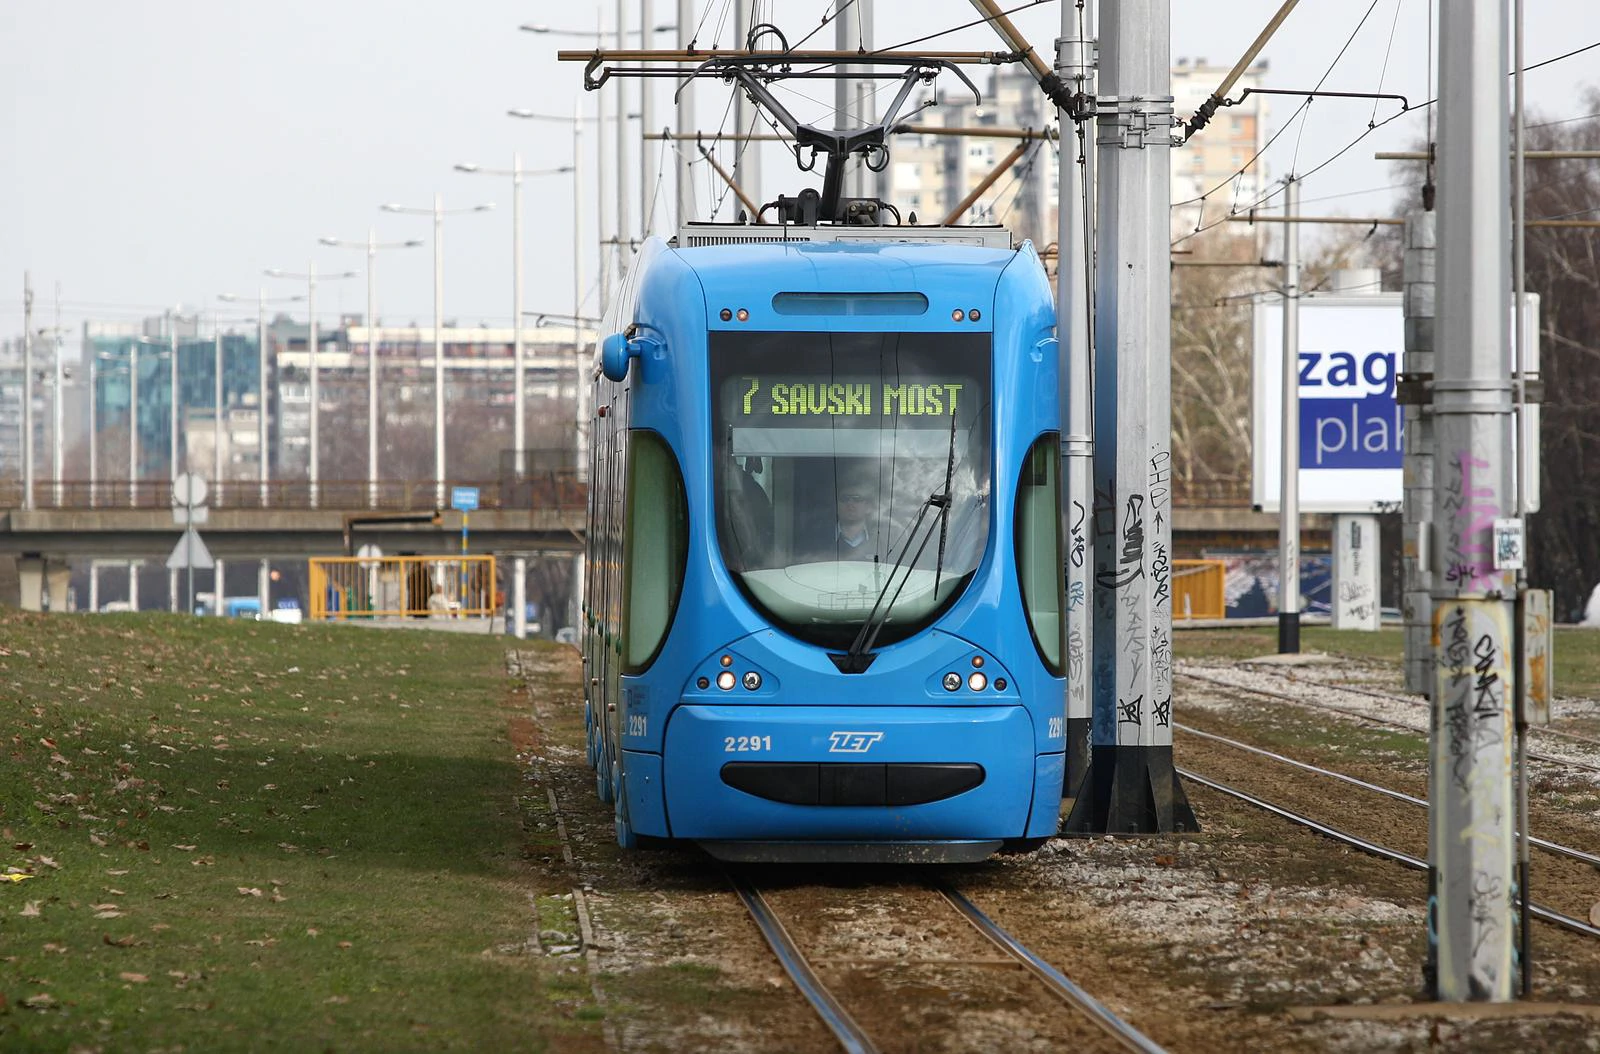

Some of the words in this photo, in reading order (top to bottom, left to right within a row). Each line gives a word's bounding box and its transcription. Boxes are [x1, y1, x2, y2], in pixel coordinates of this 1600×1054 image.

[742, 377, 759, 415] 7
[771, 383, 871, 415] SAVSKI
[883, 383, 963, 416] MOST
[629, 715, 647, 737] 2291
[1048, 717, 1063, 738] 2291
[724, 735, 772, 752] 2291
[828, 731, 884, 753] ZET
